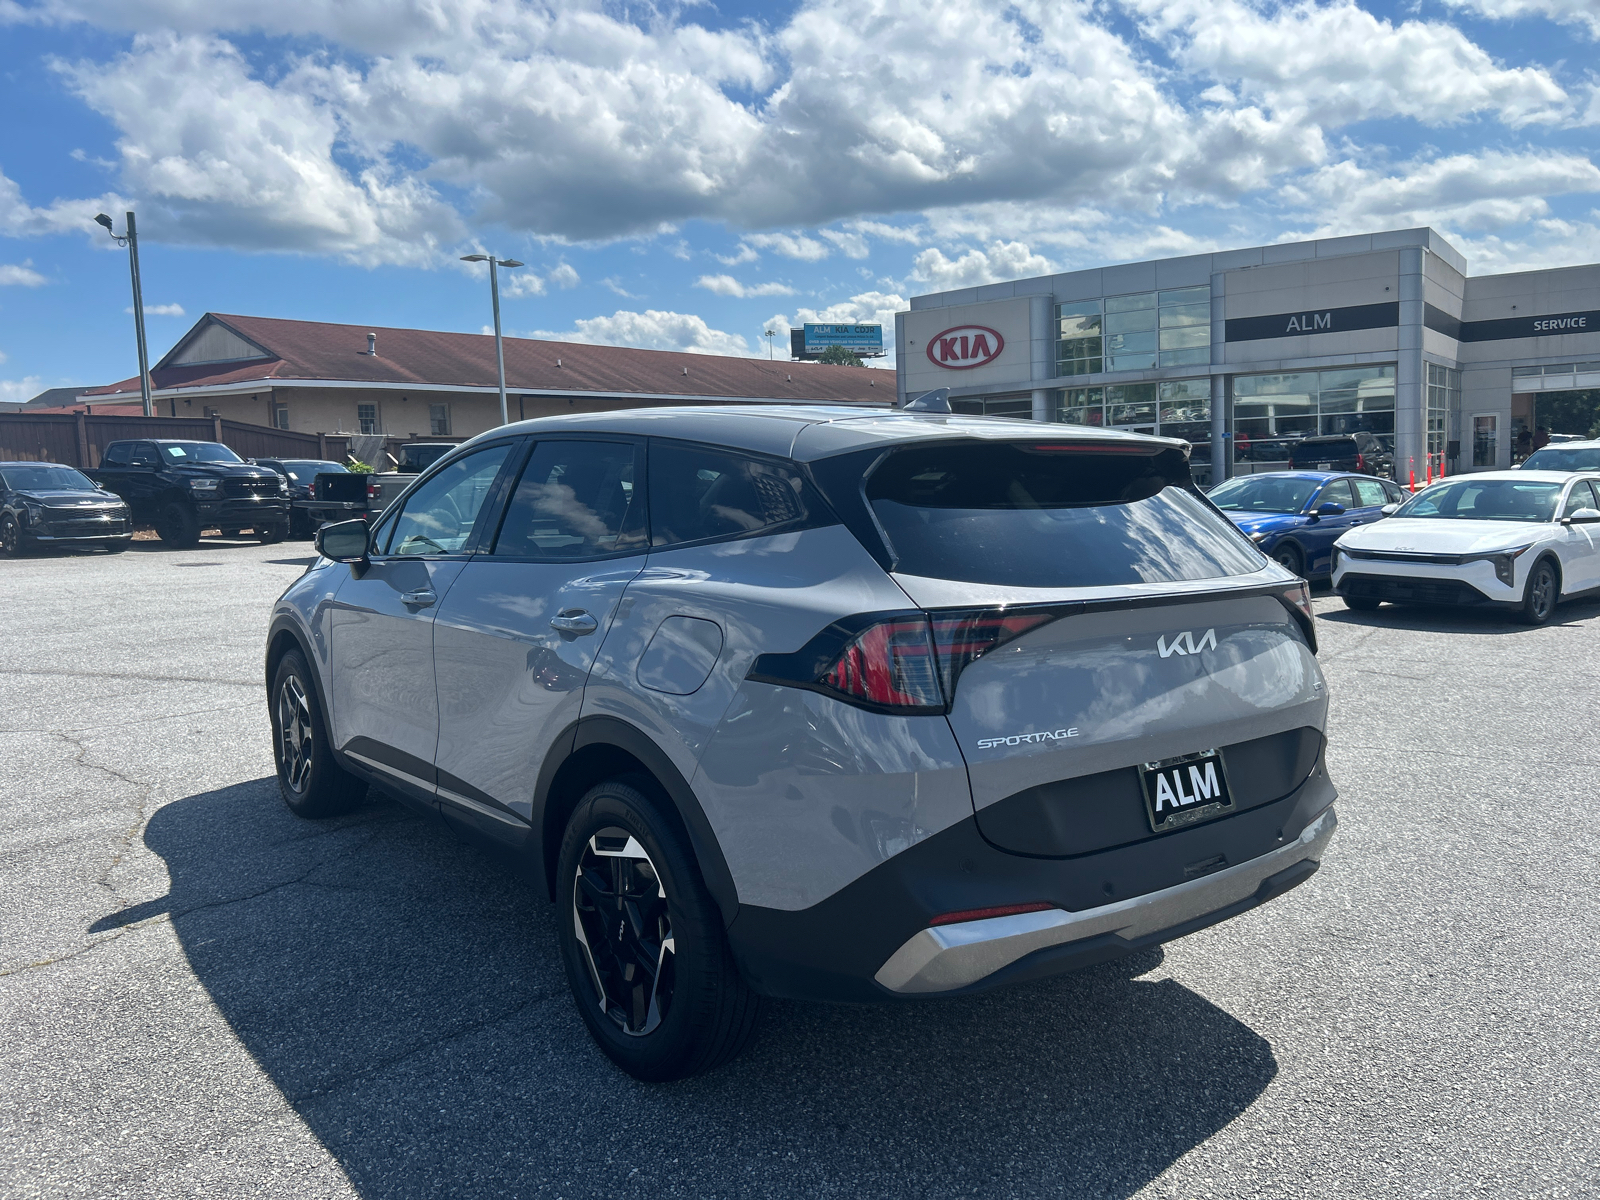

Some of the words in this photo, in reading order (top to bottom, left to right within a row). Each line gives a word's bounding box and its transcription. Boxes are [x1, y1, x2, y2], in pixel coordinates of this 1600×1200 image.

[1286, 313, 1331, 332] ALM
[1533, 317, 1586, 331] SERVICE
[939, 334, 991, 361] KIA
[1157, 628, 1217, 658] KIA
[977, 727, 1080, 749] SPORTAGE
[1156, 761, 1221, 812] ALM
